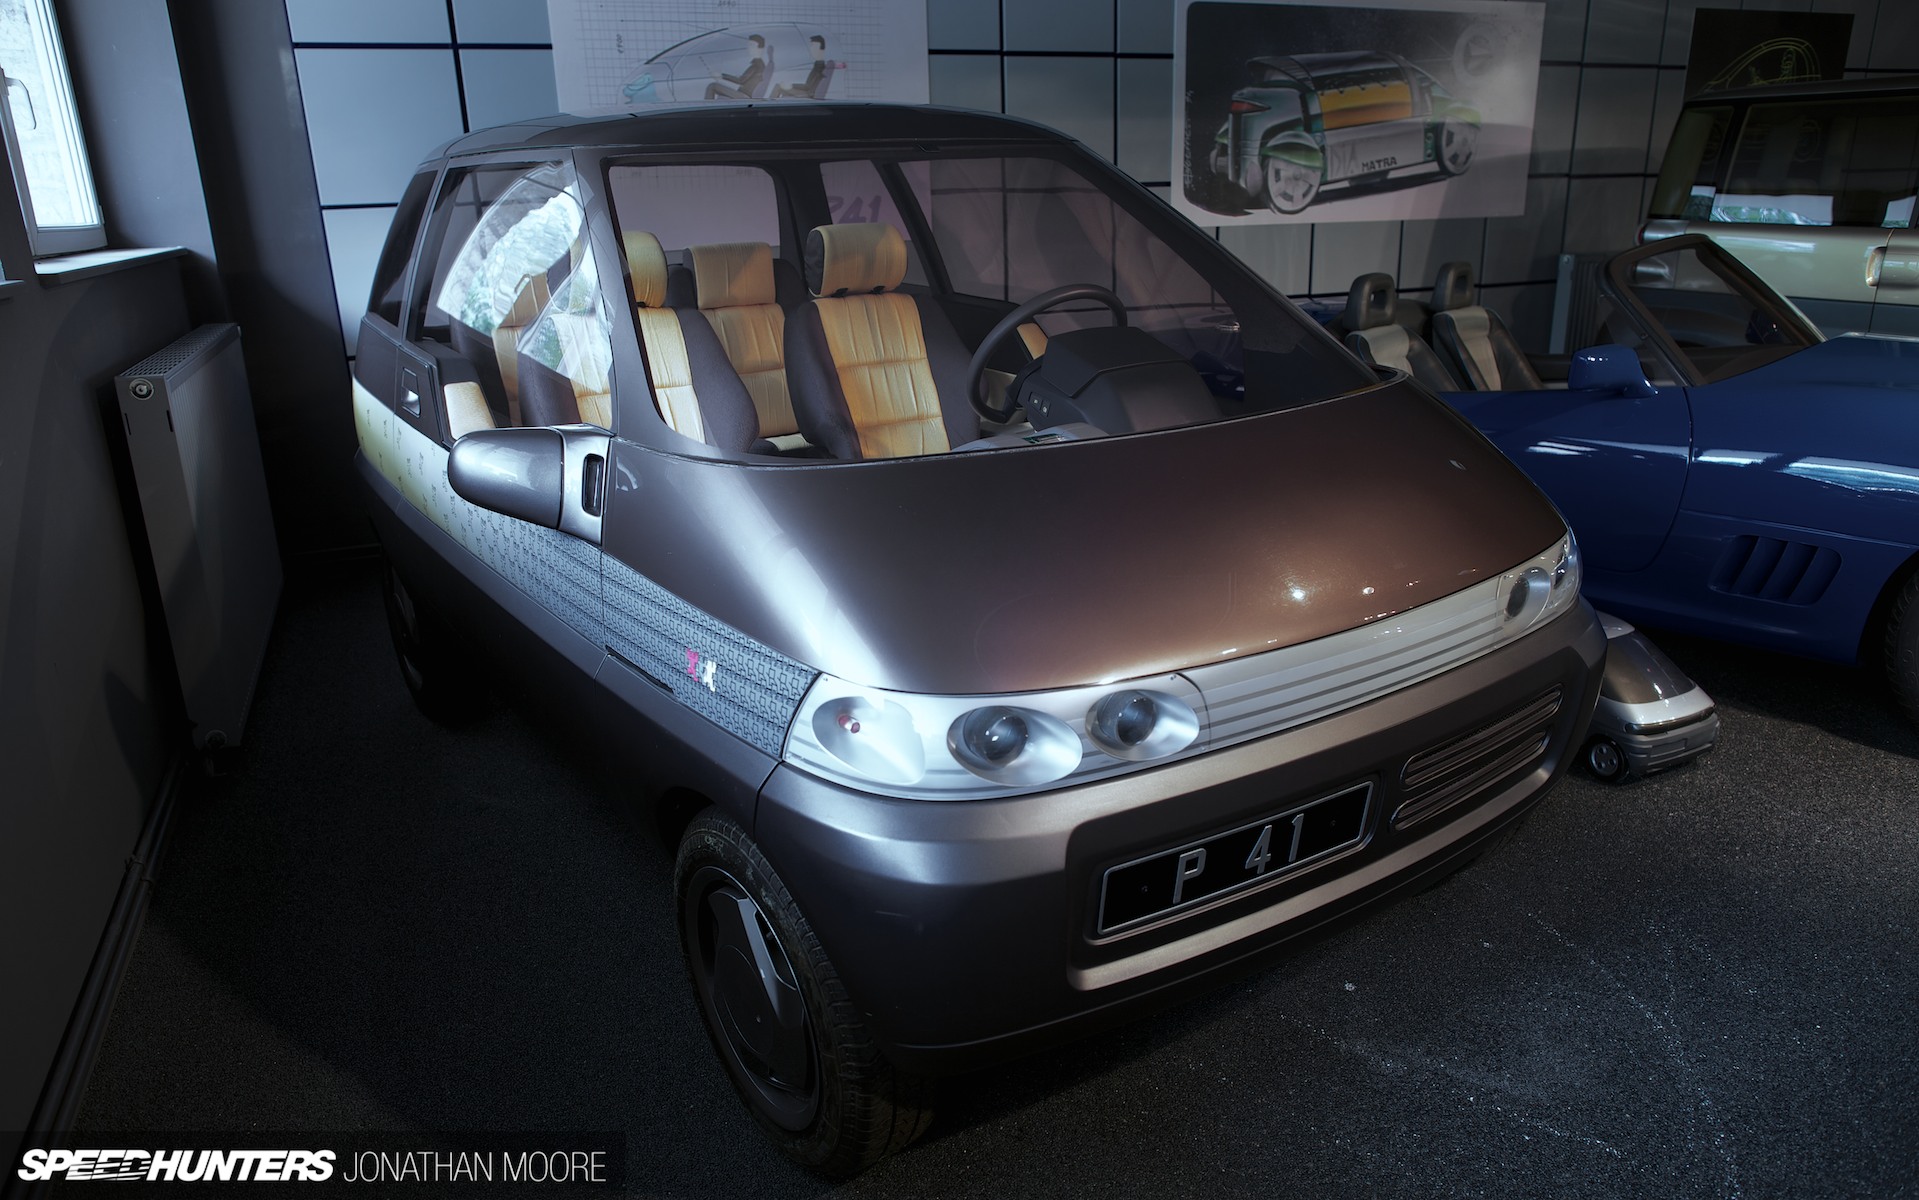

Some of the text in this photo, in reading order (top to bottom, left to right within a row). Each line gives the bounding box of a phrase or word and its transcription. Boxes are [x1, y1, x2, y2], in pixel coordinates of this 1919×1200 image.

[1361, 156, 1398, 172] MATRA
[1172, 813, 1305, 904] P 41
